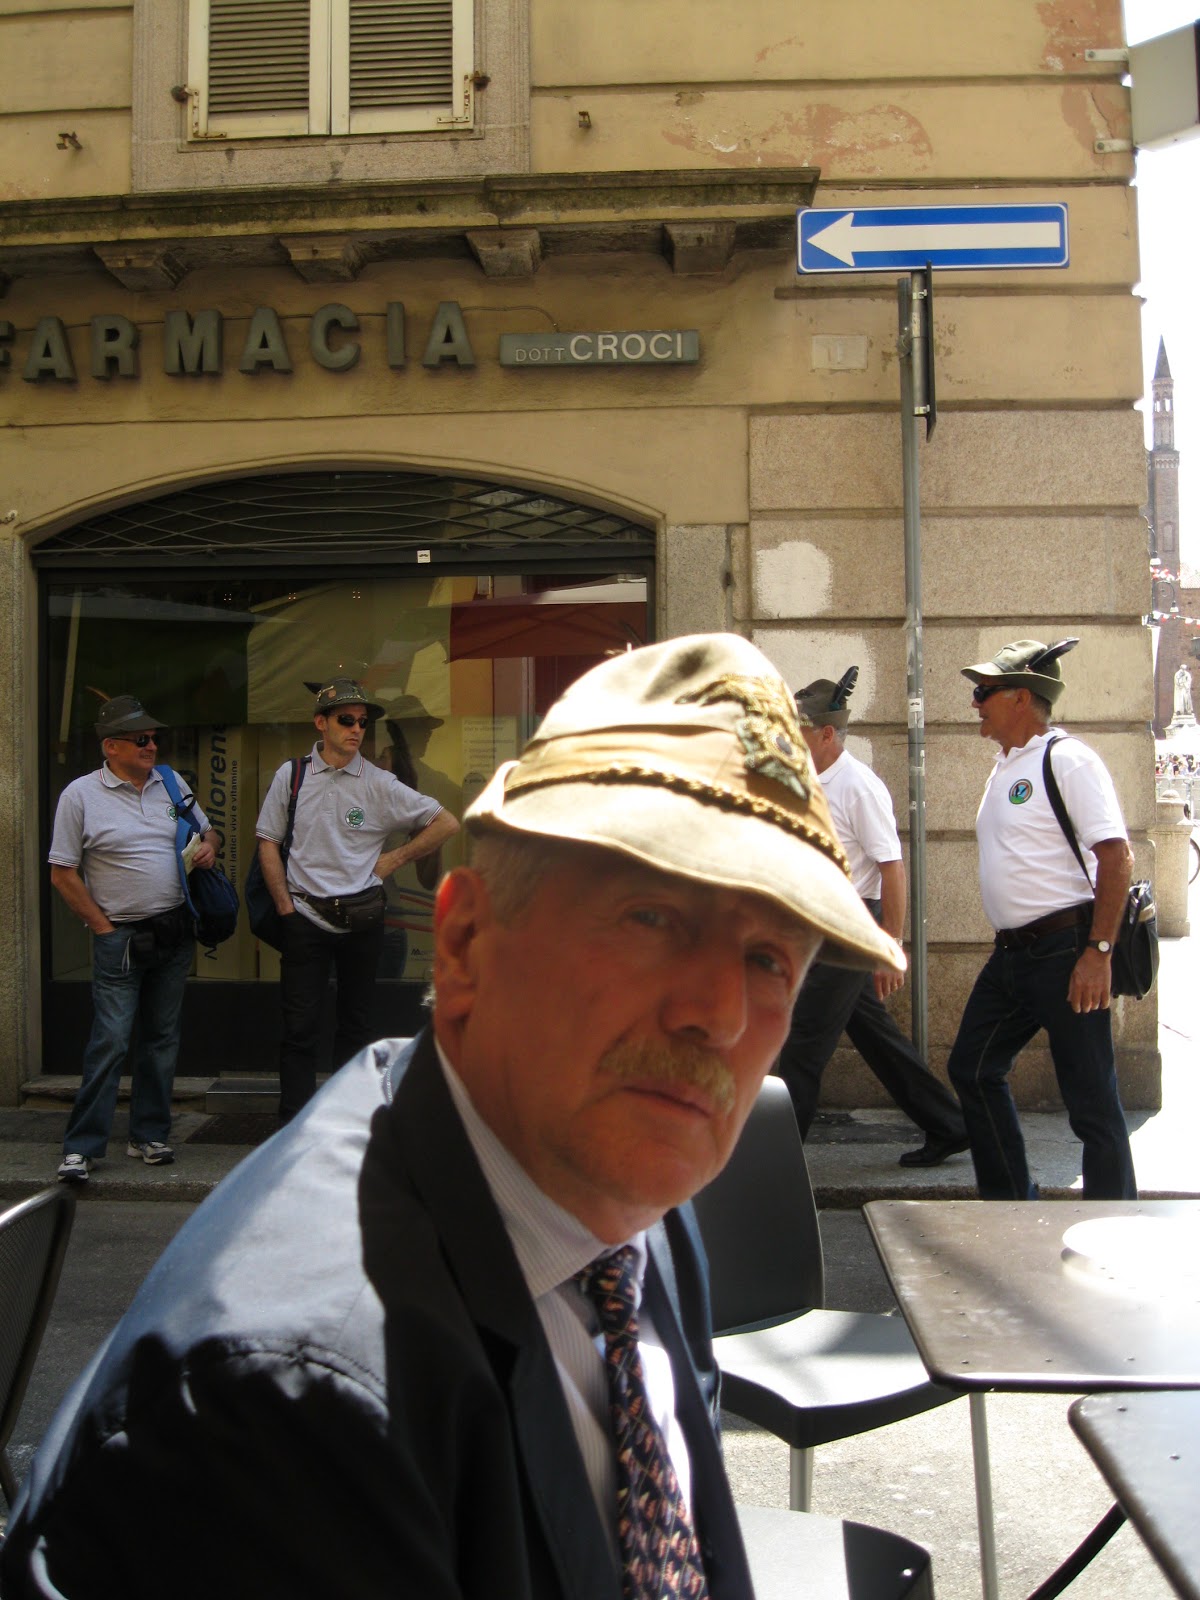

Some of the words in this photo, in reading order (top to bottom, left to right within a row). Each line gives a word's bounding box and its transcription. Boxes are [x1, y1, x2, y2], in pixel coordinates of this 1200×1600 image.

[515, 347, 565, 362] DOTT
[570, 332, 683, 361] CROCI
[230, 760, 238, 803] vitamine
[229, 814, 237, 832] vivi
[229, 834, 237, 862] lattici
